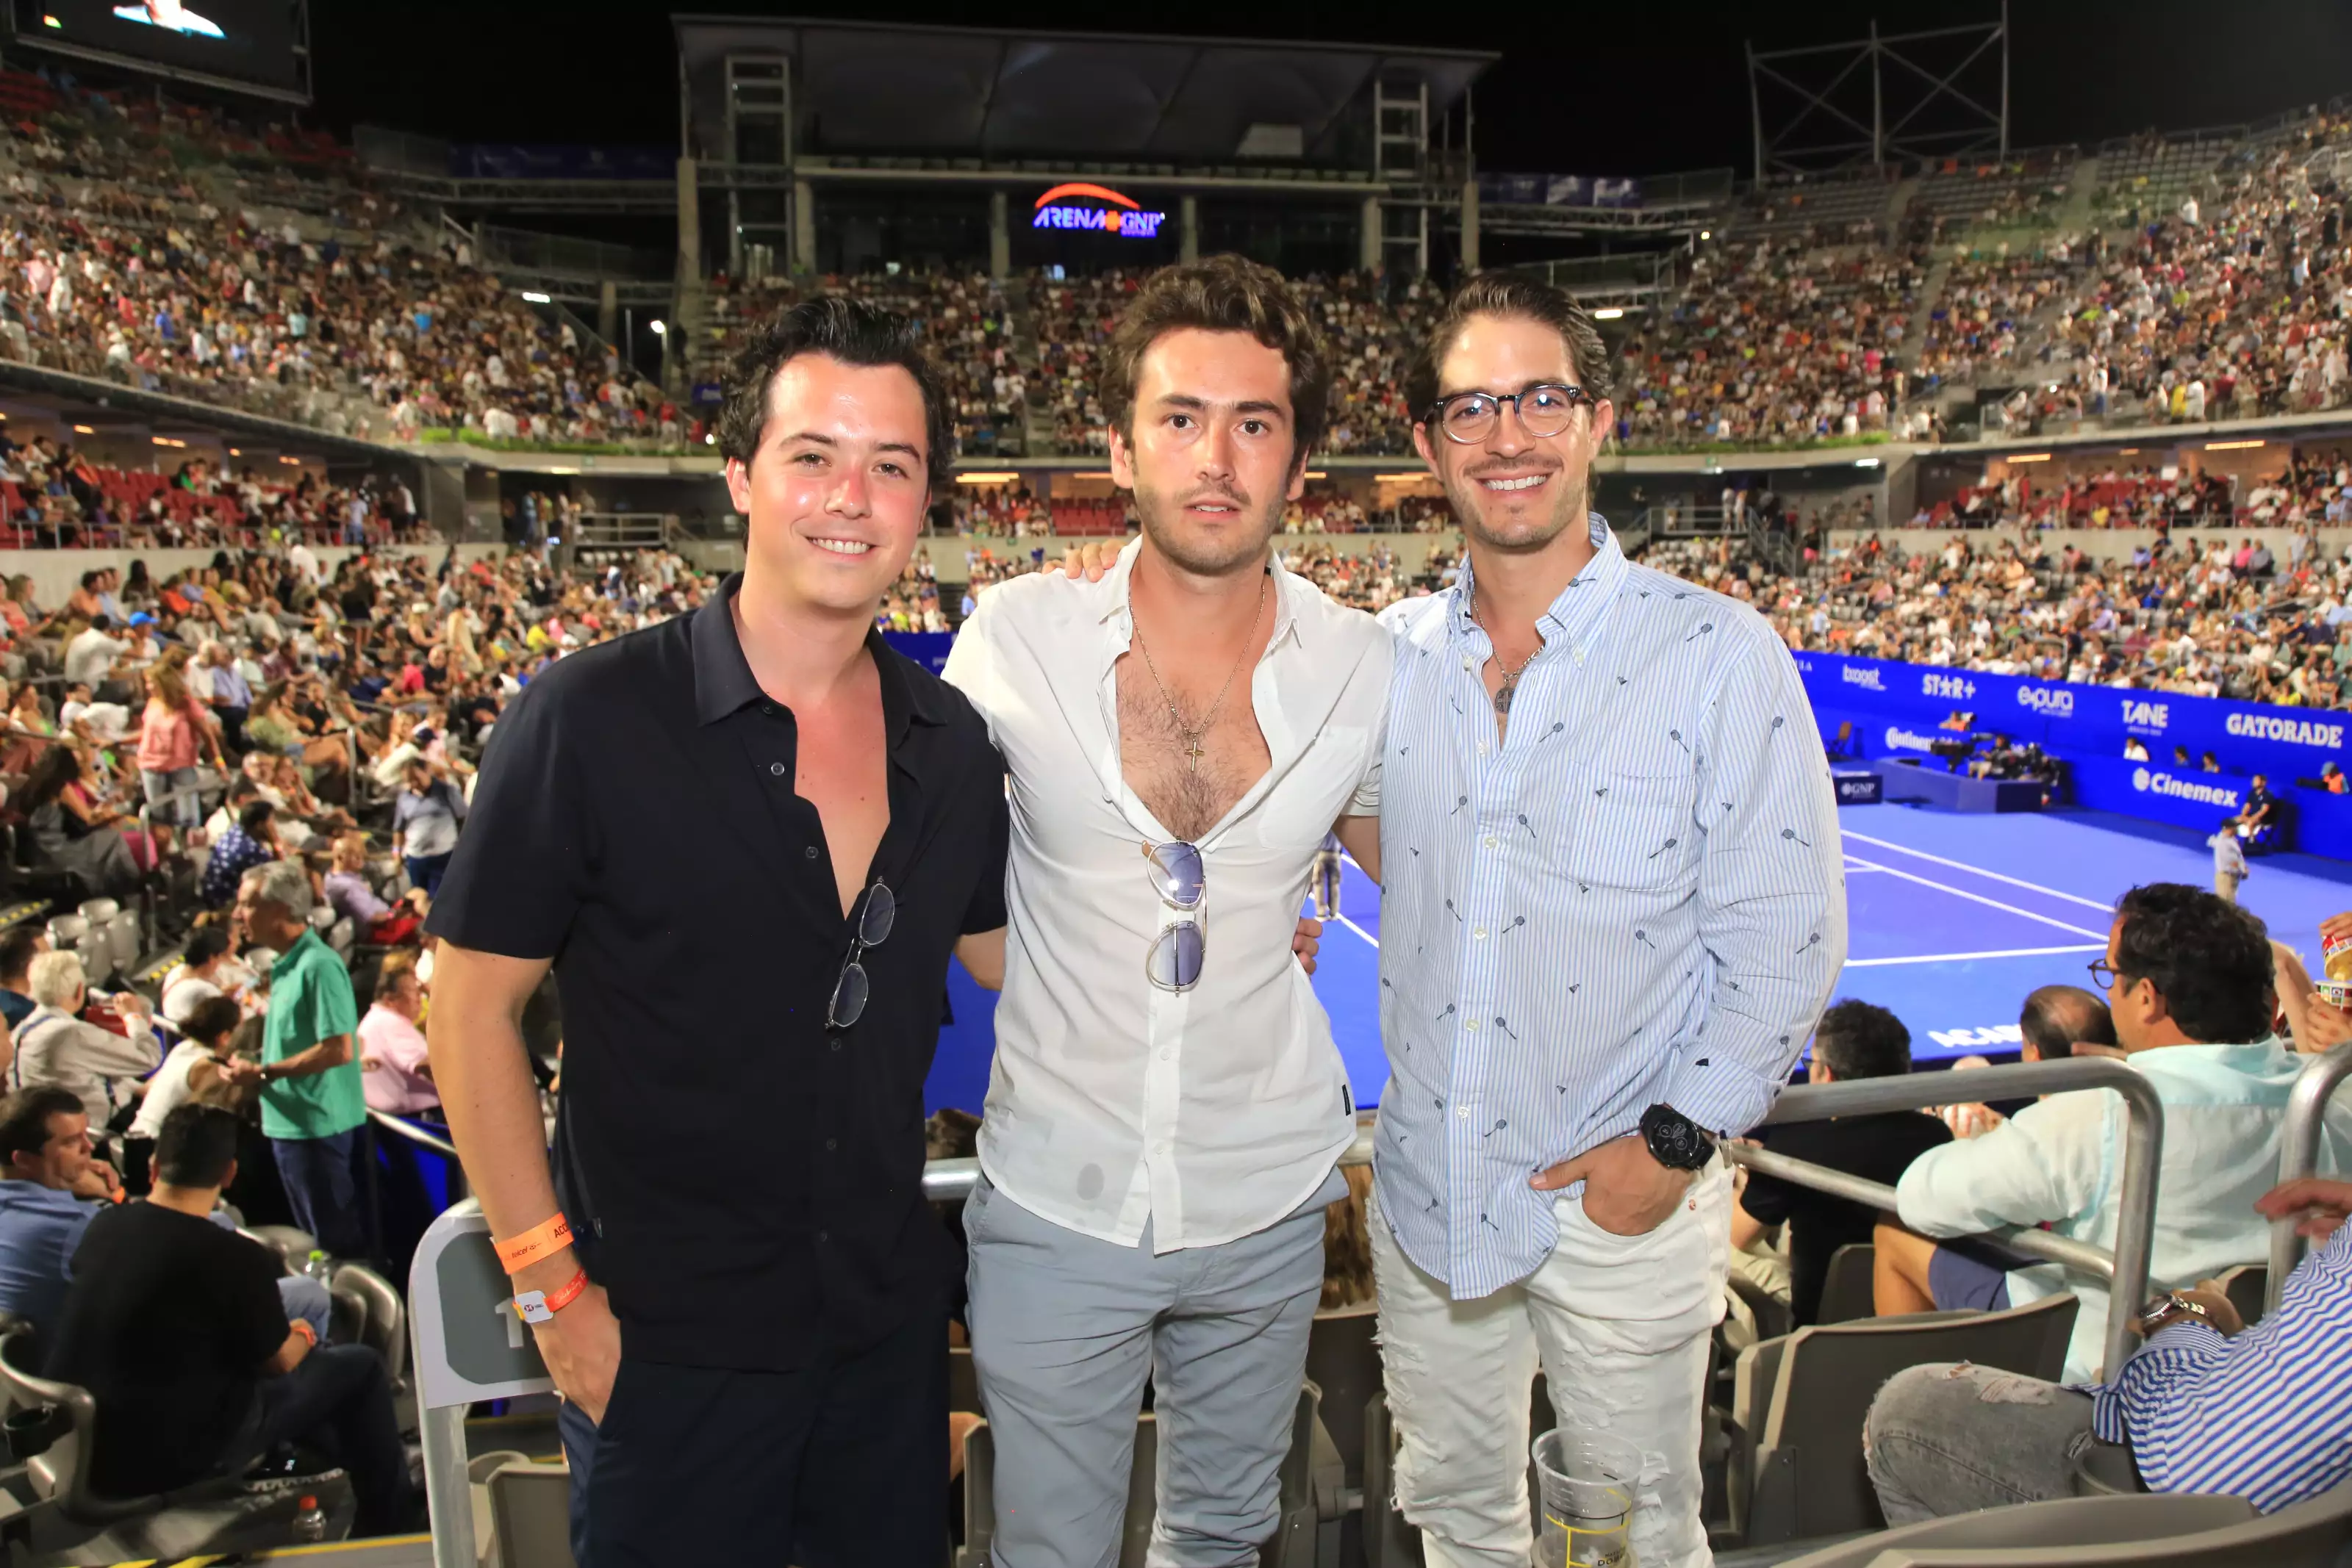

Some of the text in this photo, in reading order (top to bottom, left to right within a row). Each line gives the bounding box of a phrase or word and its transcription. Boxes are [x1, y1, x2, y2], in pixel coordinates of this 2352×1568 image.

[1033, 206, 1161, 230] ARENA GNP
[1843, 663, 1880, 684] boost
[2121, 700, 2168, 728] TANE
[2226, 713, 2343, 748] GATORADE
[1852, 783, 1875, 797] GNP
[2151, 772, 2238, 807] Cinemex
[511, 1245, 528, 1259] telcel
